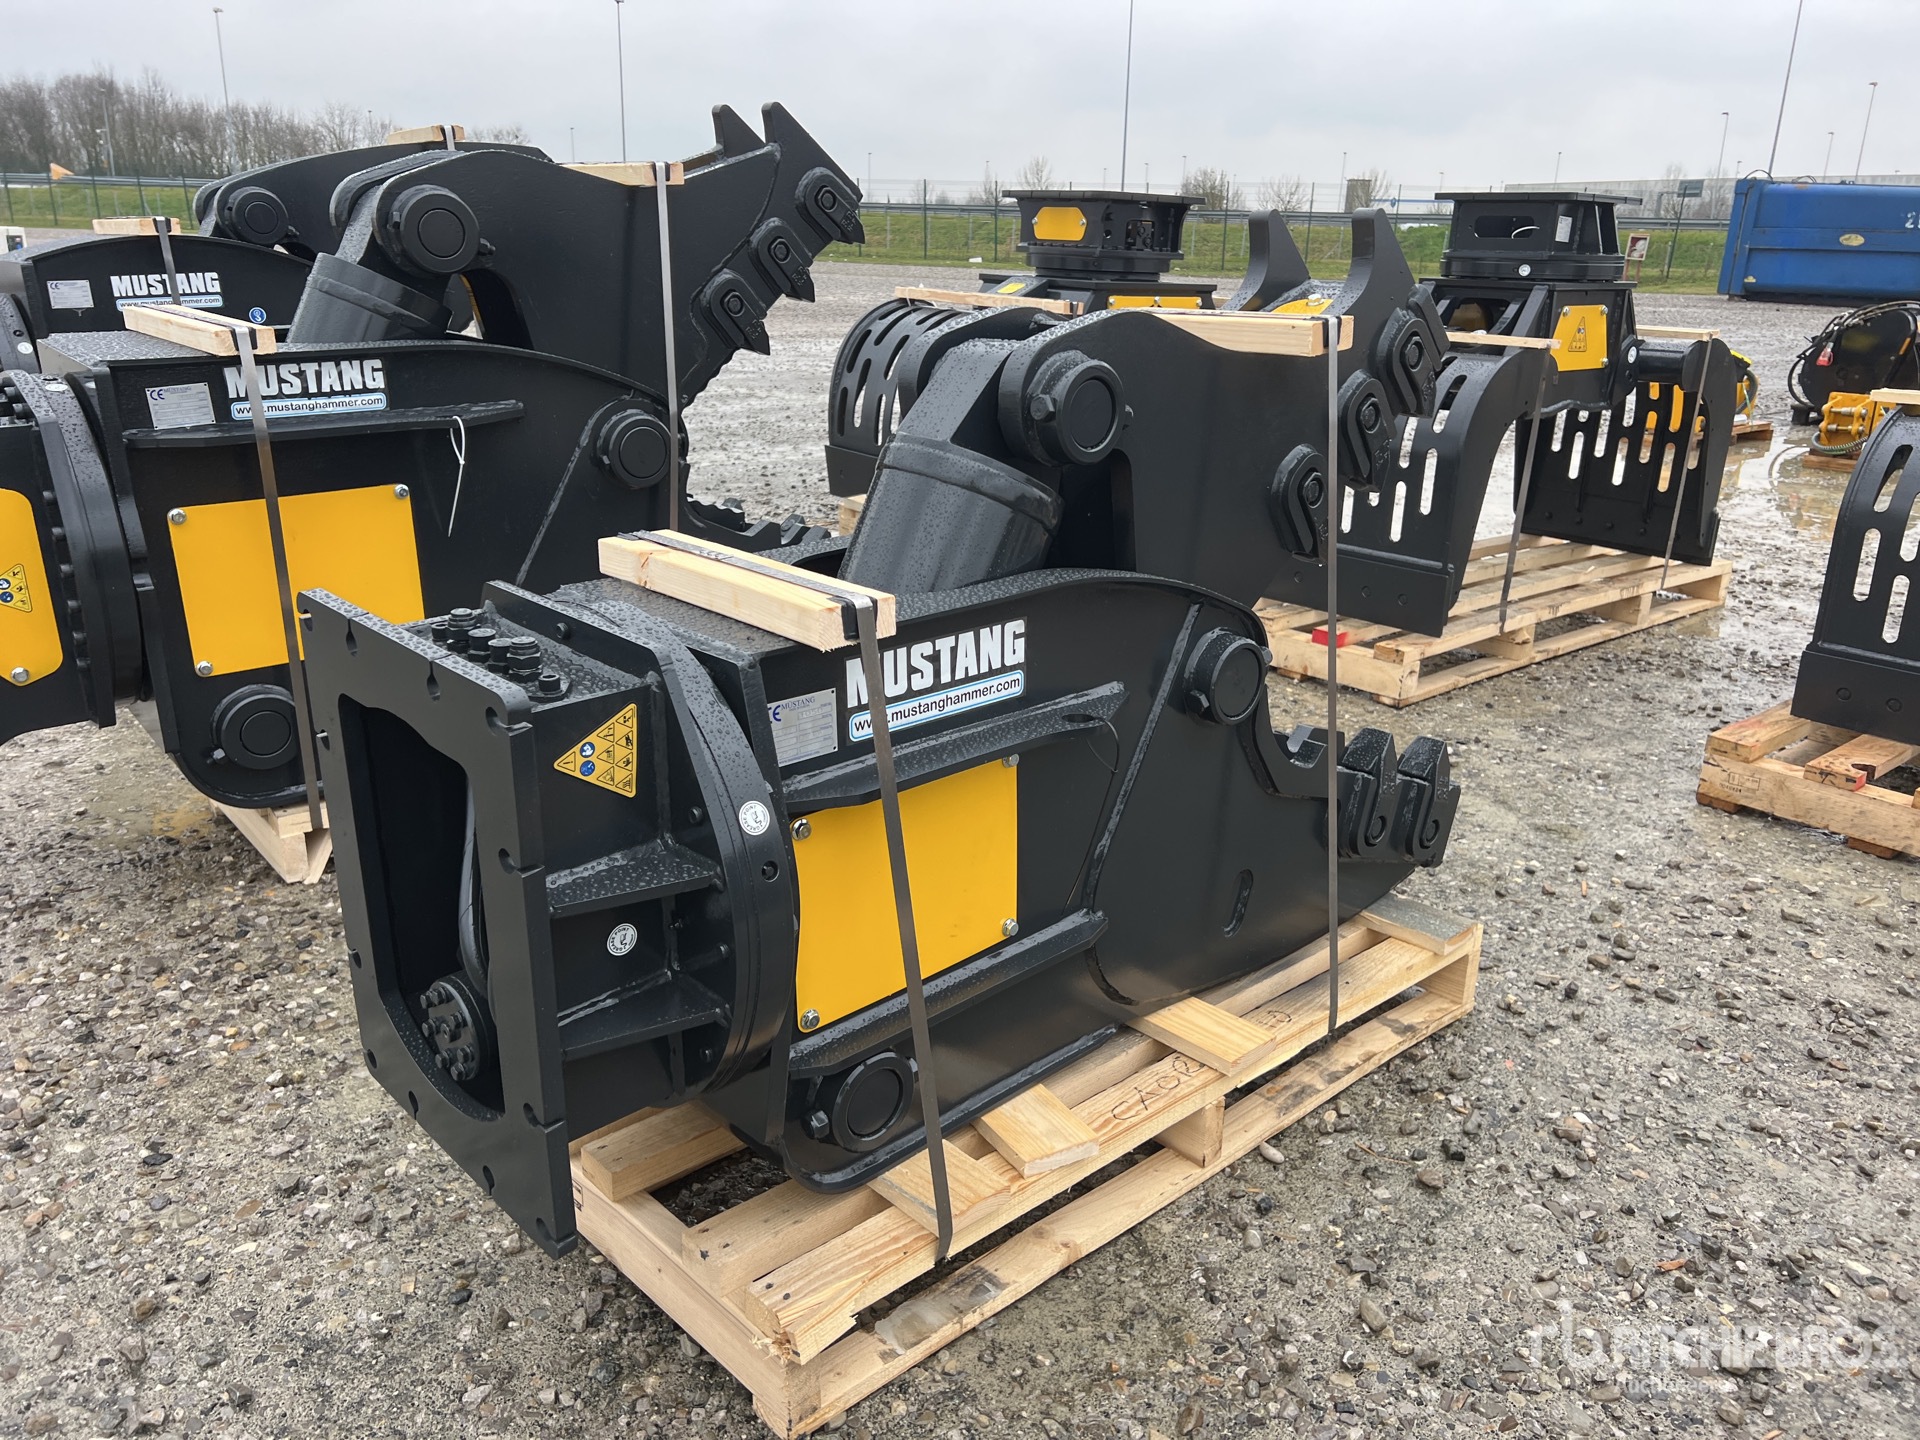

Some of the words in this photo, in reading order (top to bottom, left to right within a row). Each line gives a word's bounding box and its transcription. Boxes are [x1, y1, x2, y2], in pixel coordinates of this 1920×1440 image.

[110, 272, 221, 297] MUSTANG
[223, 359, 385, 399] MUSTANG
[235, 396, 383, 415] ww.mustanghammer.com
[846, 620, 1025, 709] MUSTANG
[854, 677, 1021, 732] ww.mustanghammer.com
